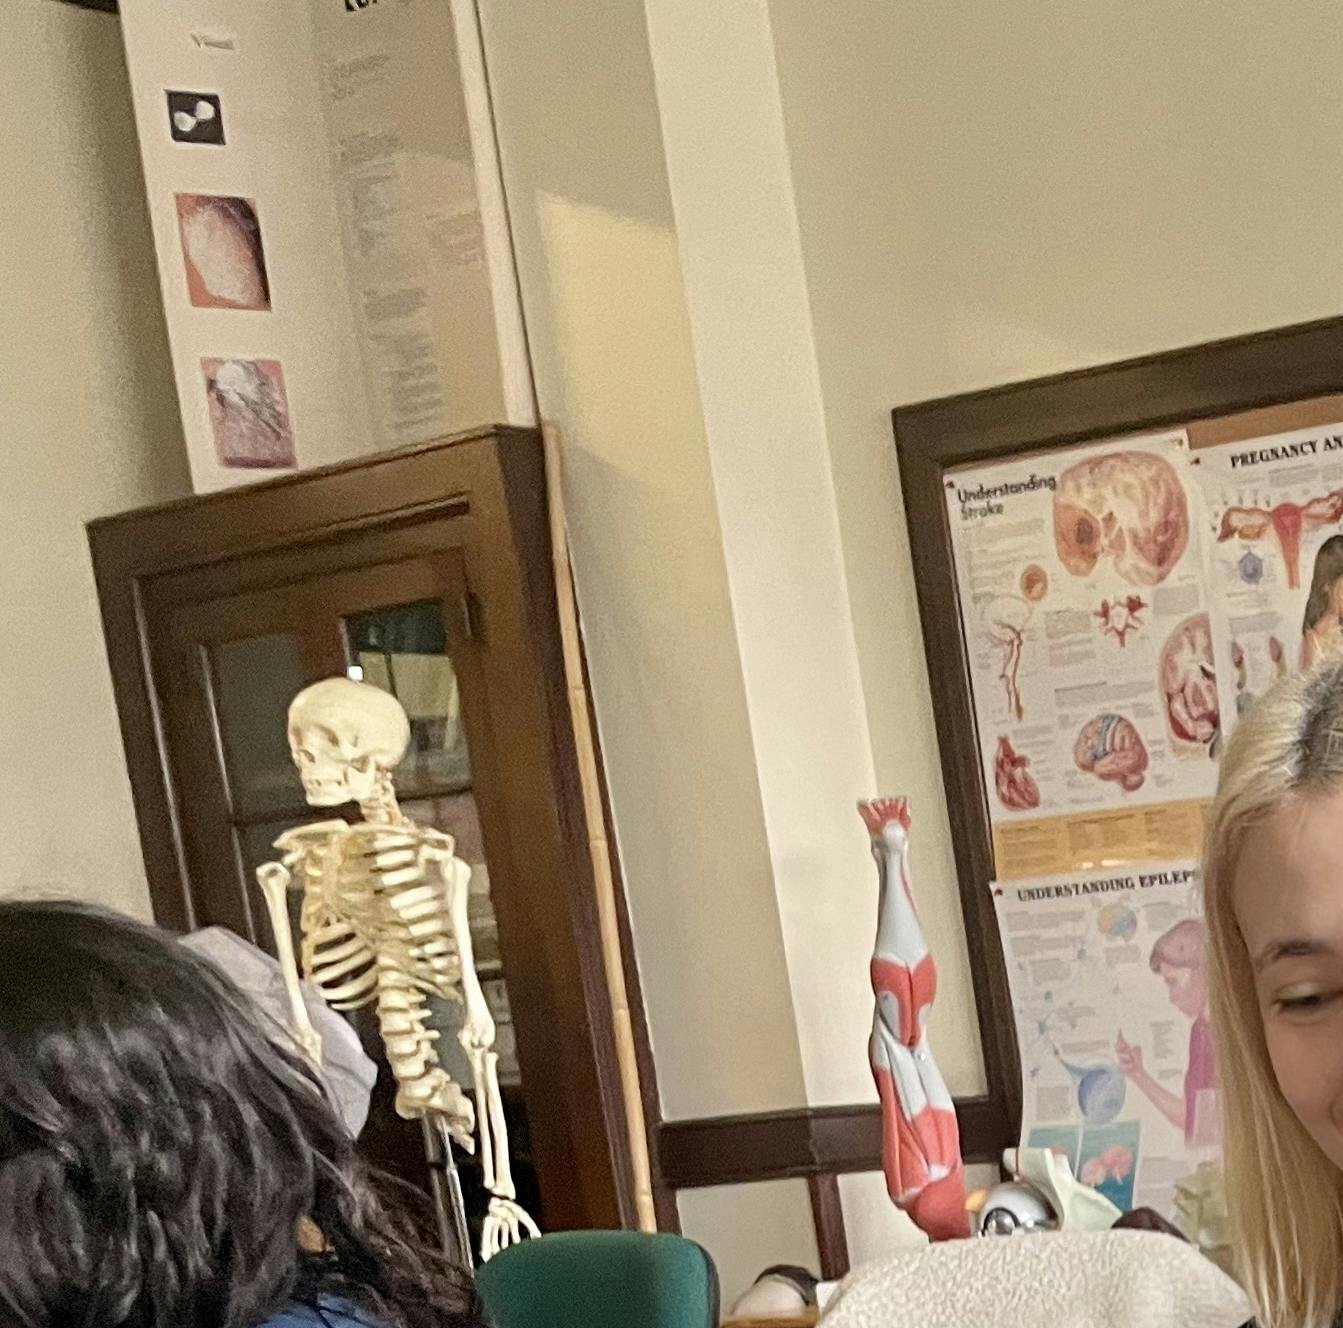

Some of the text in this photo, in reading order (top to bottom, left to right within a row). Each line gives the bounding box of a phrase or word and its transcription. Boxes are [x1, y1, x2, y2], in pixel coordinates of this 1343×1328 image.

[1229, 439, 1319, 469] PREGNANCY
[958, 473, 1057, 504] Understanding
[961, 501, 1004, 521] Stroke
[1017, 876, 1136, 902] UNDERSTANDING
